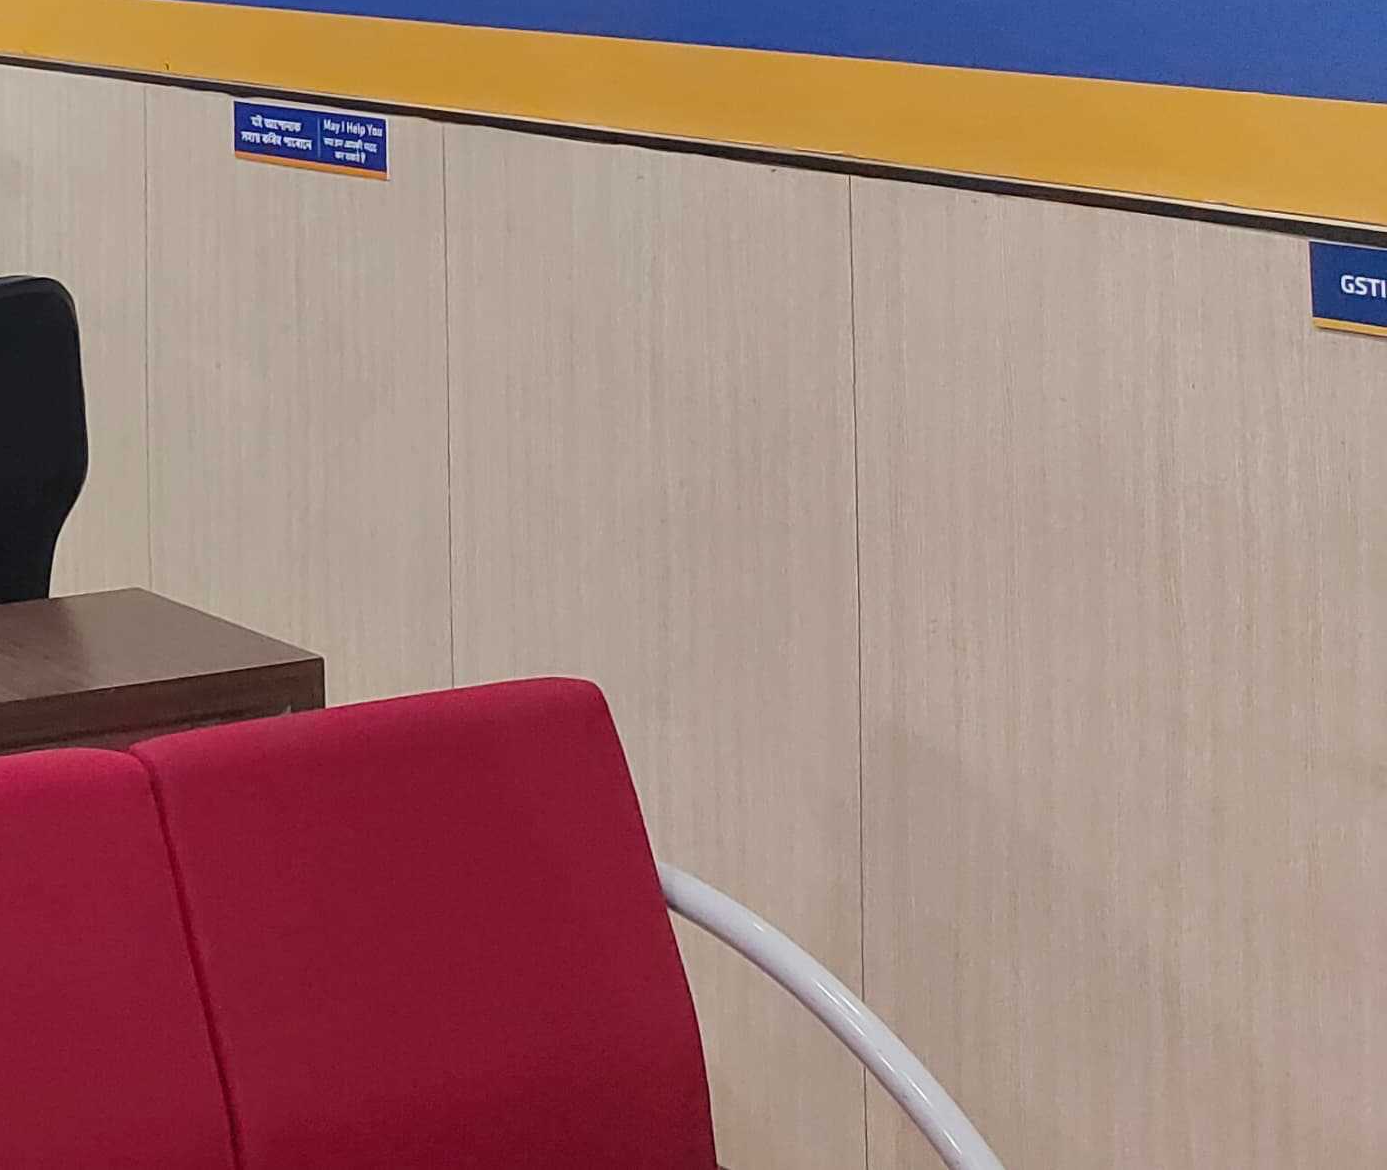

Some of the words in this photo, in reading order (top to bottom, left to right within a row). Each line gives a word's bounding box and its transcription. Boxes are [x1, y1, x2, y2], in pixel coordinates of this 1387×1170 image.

[323, 119, 340, 134] May
[341, 120, 345, 132] I
[346, 121, 366, 137] Help
[366, 124, 383, 137] You
